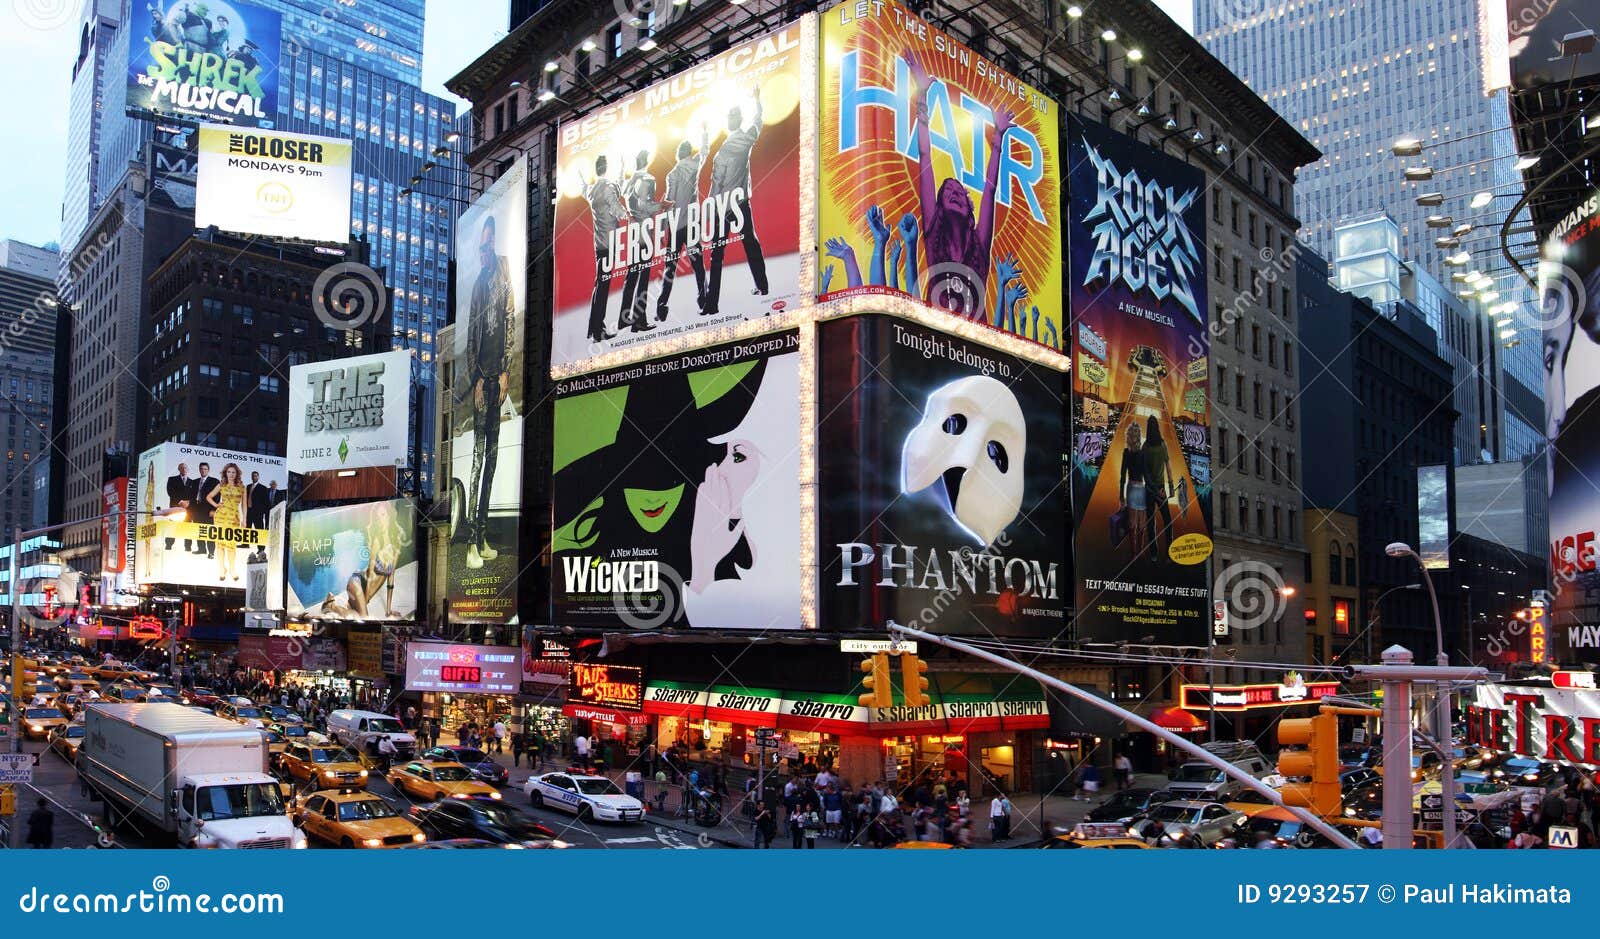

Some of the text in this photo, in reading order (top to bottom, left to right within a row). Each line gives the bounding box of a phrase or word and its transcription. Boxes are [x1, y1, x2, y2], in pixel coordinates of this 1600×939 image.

[146, 39, 265, 99] SHREK
[840, 1, 1048, 114] LET THE SUN SHINE IN
[137, 73, 266, 118] THE MUSICAL
[562, 29, 799, 147] BEST MUSICAL
[230, 133, 323, 163] THE CLOSER
[838, 50, 1048, 226] HAIR
[228, 158, 322, 177] MONDAYS 9pm
[1082, 137, 1200, 250] ROCK
[601, 187, 745, 273] JERSEY BOYS
[1136, 222, 1154, 243] OF
[1082, 218, 1202, 325] AGES
[1119, 302, 1176, 328] A NEW MUSICAL
[615, 339, 635, 348] AUGUST
[636, 333, 657, 344] WILSON
[893, 324, 1022, 382] Tonight belongs to...
[570, 378, 595, 391] MUCH
[597, 368, 643, 387] HAPPENED
[645, 362, 680, 377] BEFORE
[681, 351, 730, 370] DOROTHY
[733, 340, 783, 359] DROPPED
[785, 334, 799, 347] IN
[307, 360, 385, 403] THE
[305, 408, 384, 432] IS NEAR
[306, 394, 385, 416] BEGINNING
[180, 447, 283, 467] OR YOU'LL CROSS THE LINE.
[300, 448, 324, 459] JUNE
[326, 447, 332, 457] 2
[199, 525, 259, 544] THE CLOSER
[610, 547, 659, 558] A NEW MUSICAL
[562, 556, 659, 593] WICKED
[835, 542, 1059, 599] PHANTOM
[1085, 579, 1102, 590] TEXT
[1136, 583, 1143, 593] to
[1143, 585, 1164, 595] 56543
[1164, 586, 1174, 596] for
[1174, 587, 1190, 597] FREE
[1530, 608, 1545, 663] PARK
[442, 667, 479, 682] GIFTS
[595, 682, 637, 701] STEAKS
[652, 686, 699, 704] sbarro
[717, 691, 771, 712] sbarro
[791, 698, 854, 720] sbarro
[890, 704, 937, 722] sbarro
[950, 698, 993, 717] sbarro
[1004, 699, 1043, 716] sbarro
[562, 792, 578, 804] NYPD
